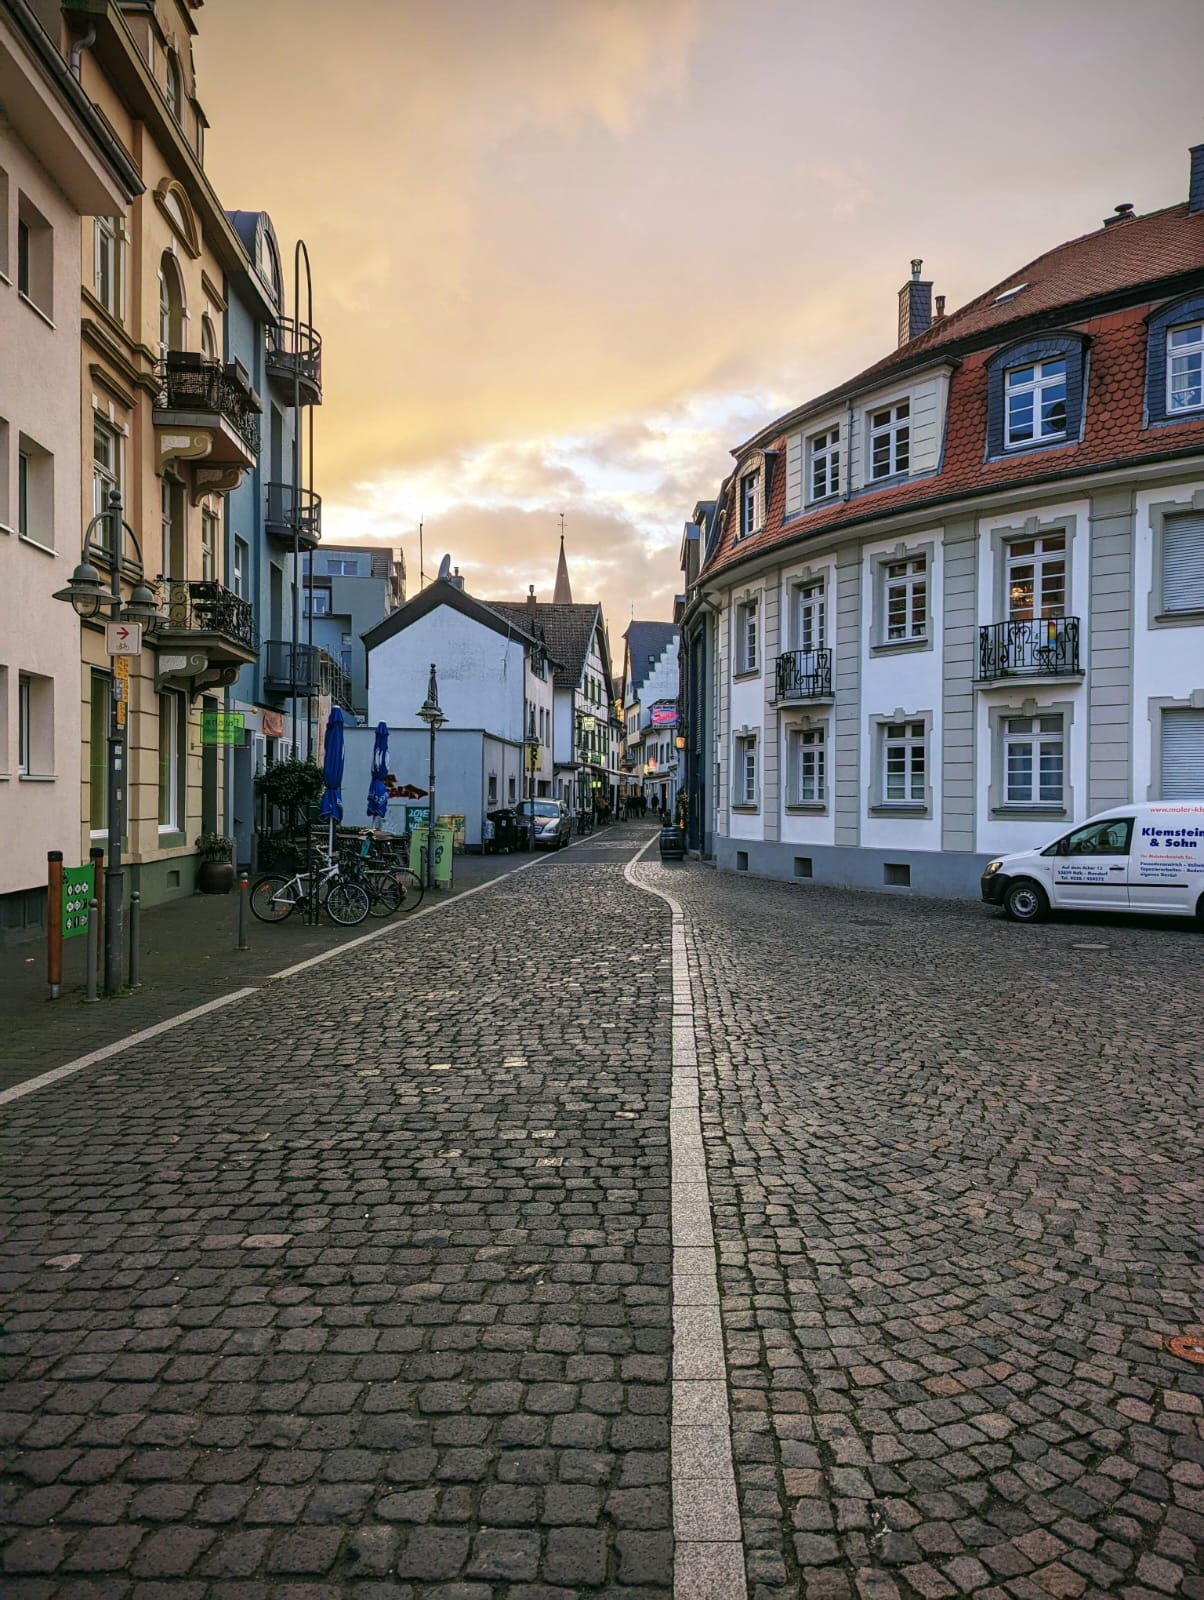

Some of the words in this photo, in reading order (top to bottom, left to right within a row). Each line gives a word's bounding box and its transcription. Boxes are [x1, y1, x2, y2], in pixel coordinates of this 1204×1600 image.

[408, 809, 430, 817] LOVE
[1142, 827, 1204, 837] Klemstein
[1150, 838, 1159, 847] &
[1165, 838, 1197, 848] Sohn
